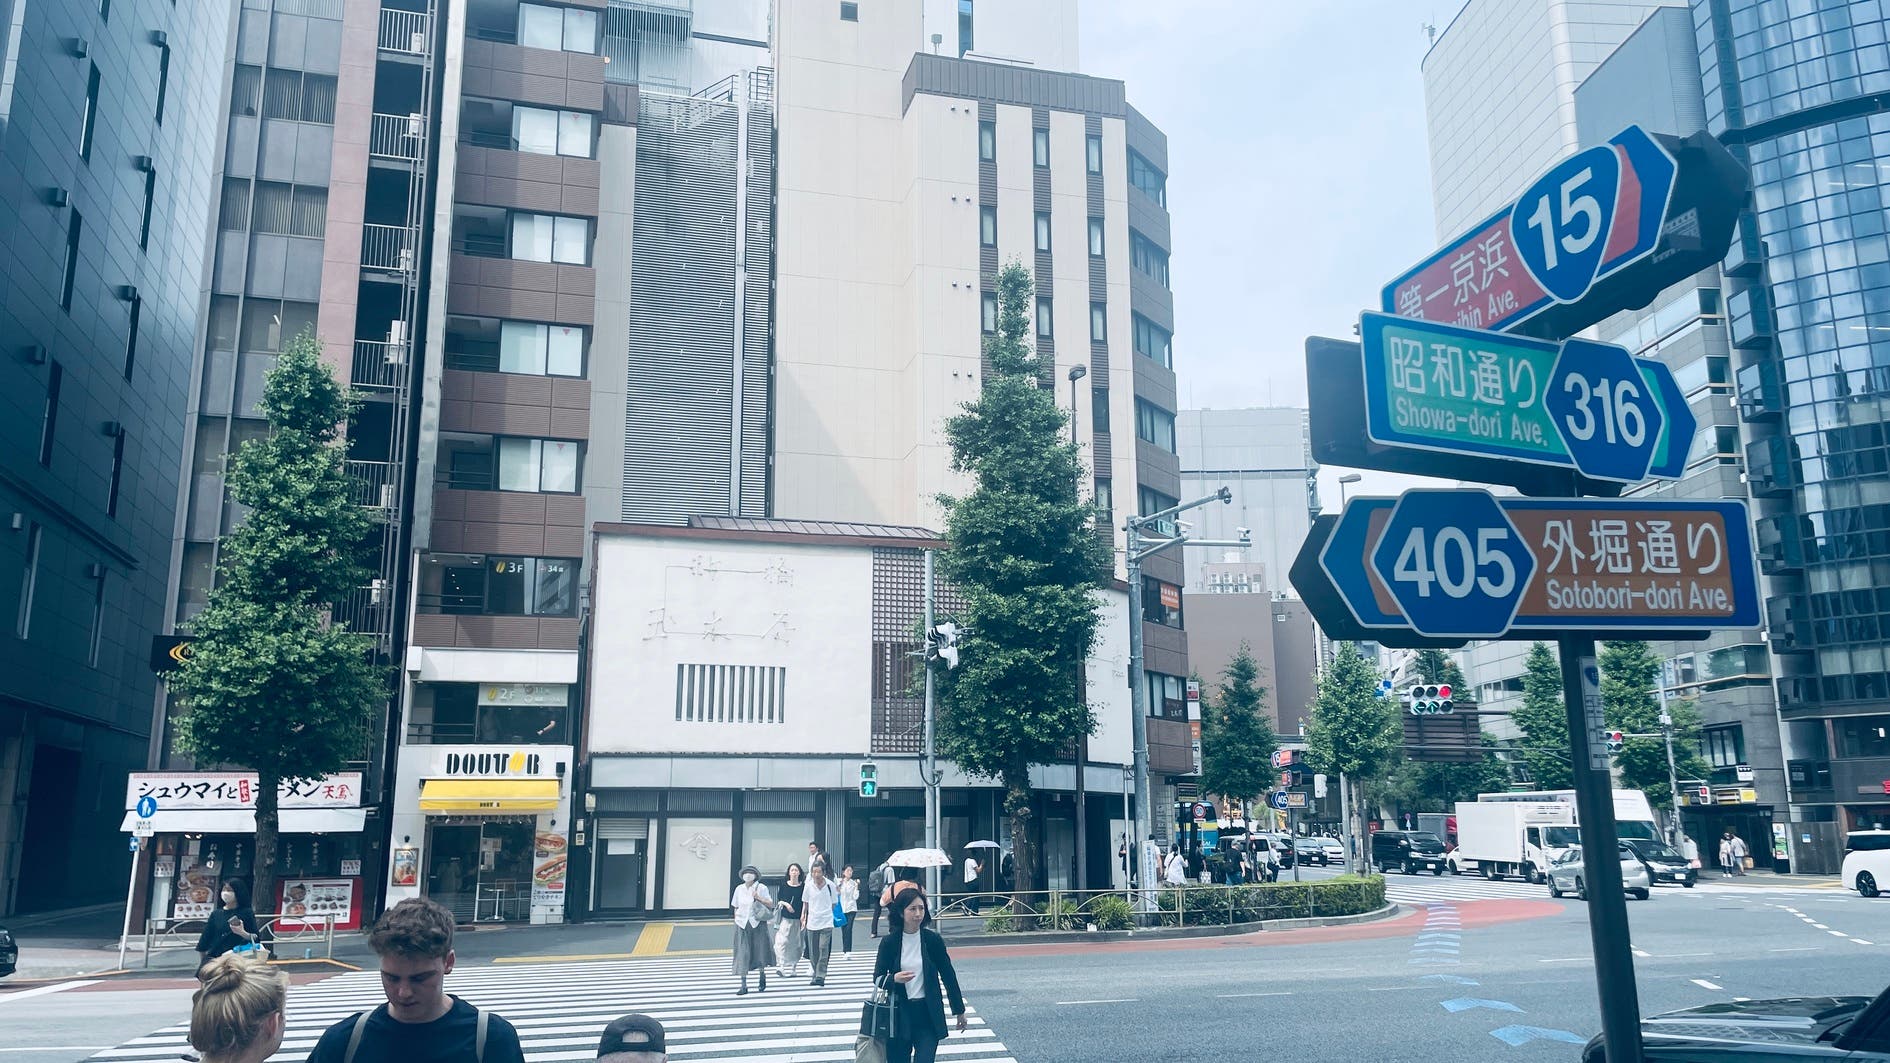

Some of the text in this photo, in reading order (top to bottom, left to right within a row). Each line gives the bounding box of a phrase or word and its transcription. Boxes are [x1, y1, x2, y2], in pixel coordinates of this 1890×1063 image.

[1527, 166, 1601, 271] 15
[1400, 230, 1508, 318] 第一京浜
[1487, 290, 1519, 320] Ave.
[1390, 336, 1536, 408] 昭和通り
[1396, 396, 1548, 446] Showa-dori Ave.
[1564, 372, 1647, 448] 316
[1393, 526, 1516, 599] 405
[1543, 519, 1721, 574] 外堀通り
[1546, 579, 1735, 612] Sotobori-dori Ave.
[137, 781, 237, 799] シュウマイと
